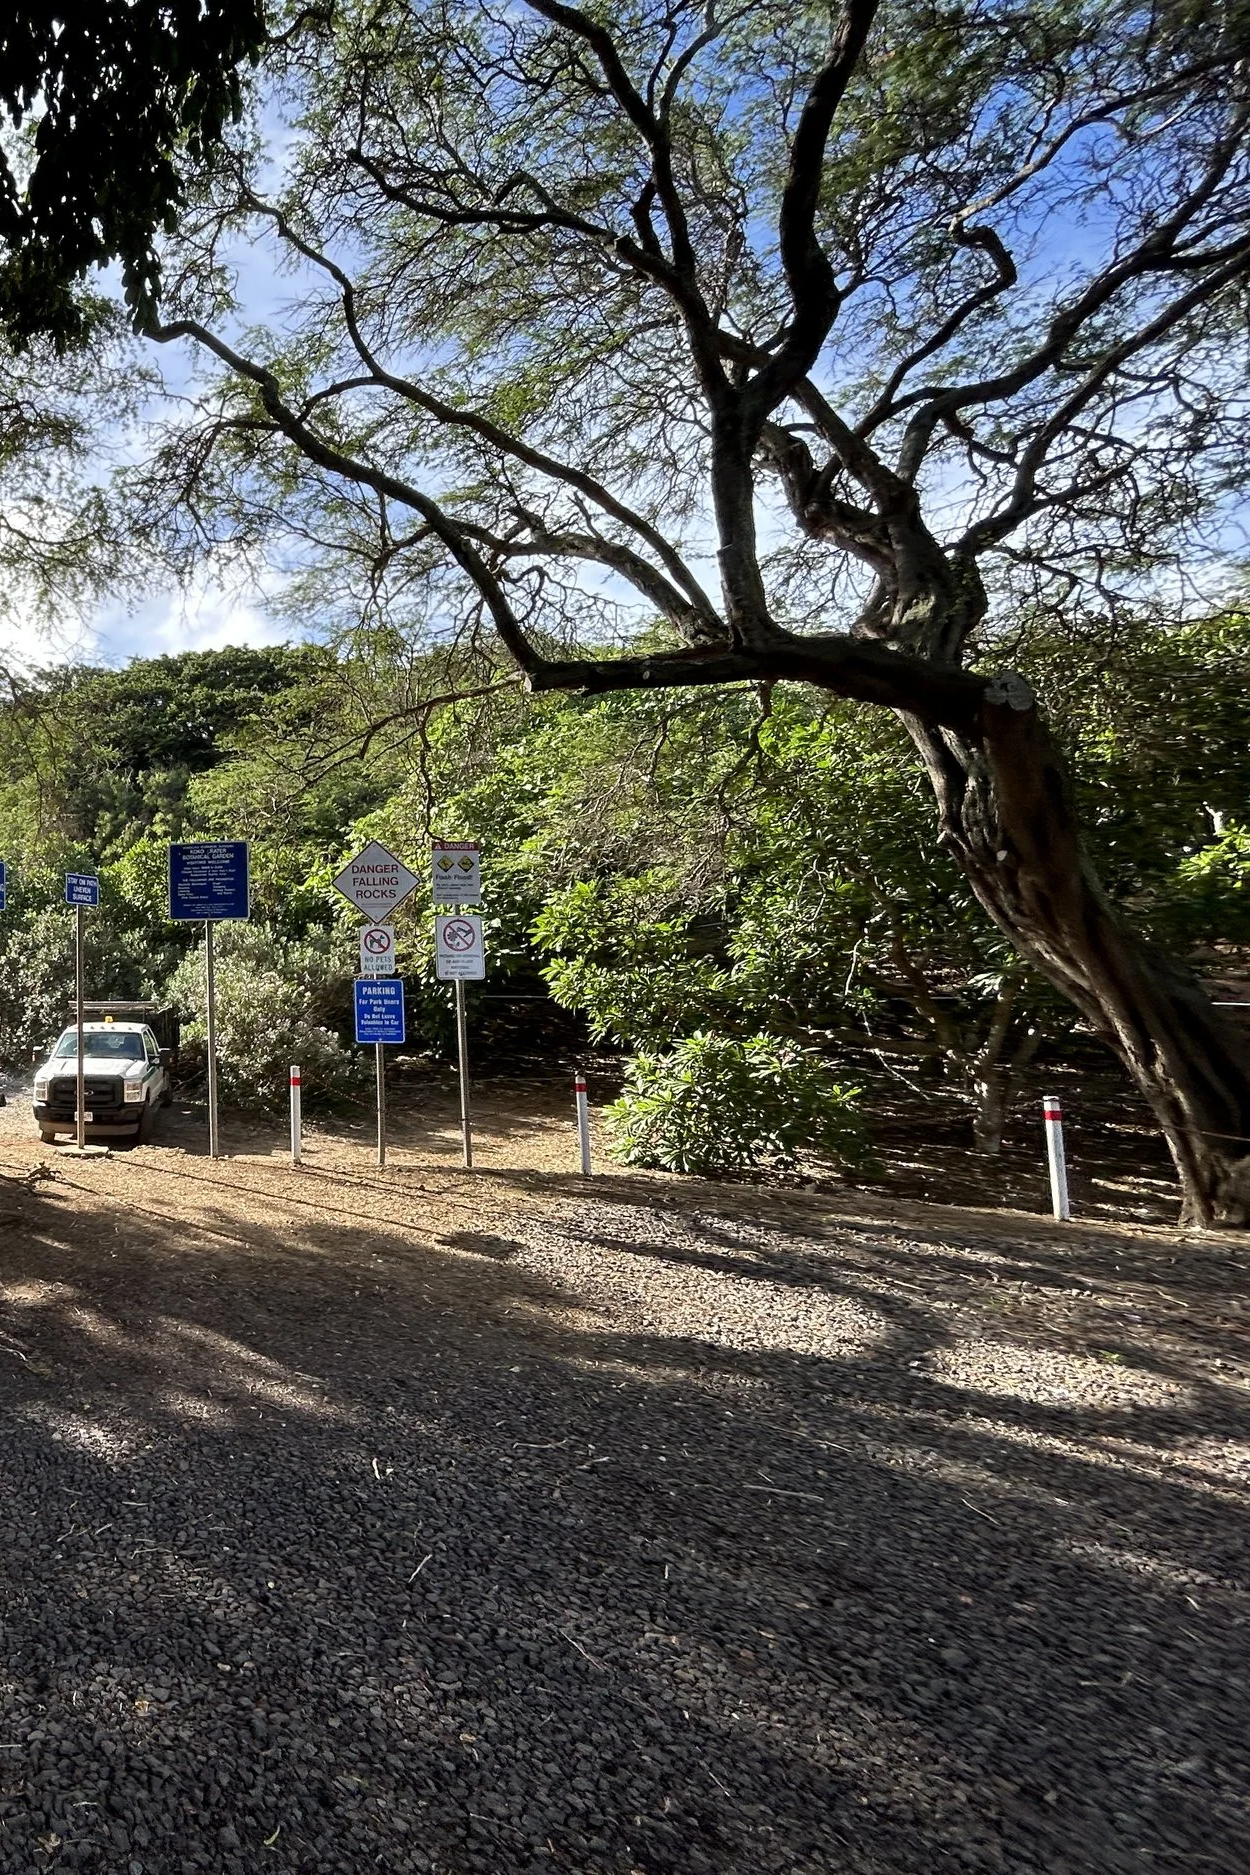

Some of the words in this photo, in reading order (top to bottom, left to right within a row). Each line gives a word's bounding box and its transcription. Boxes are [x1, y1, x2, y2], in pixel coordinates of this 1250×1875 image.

[352, 864, 398, 874] DANGER
[353, 876, 398, 886] FALLING
[74, 885, 91, 894] UNEVEN
[356, 890, 396, 898] ROCKS
[72, 893, 92, 902] SURFACE
